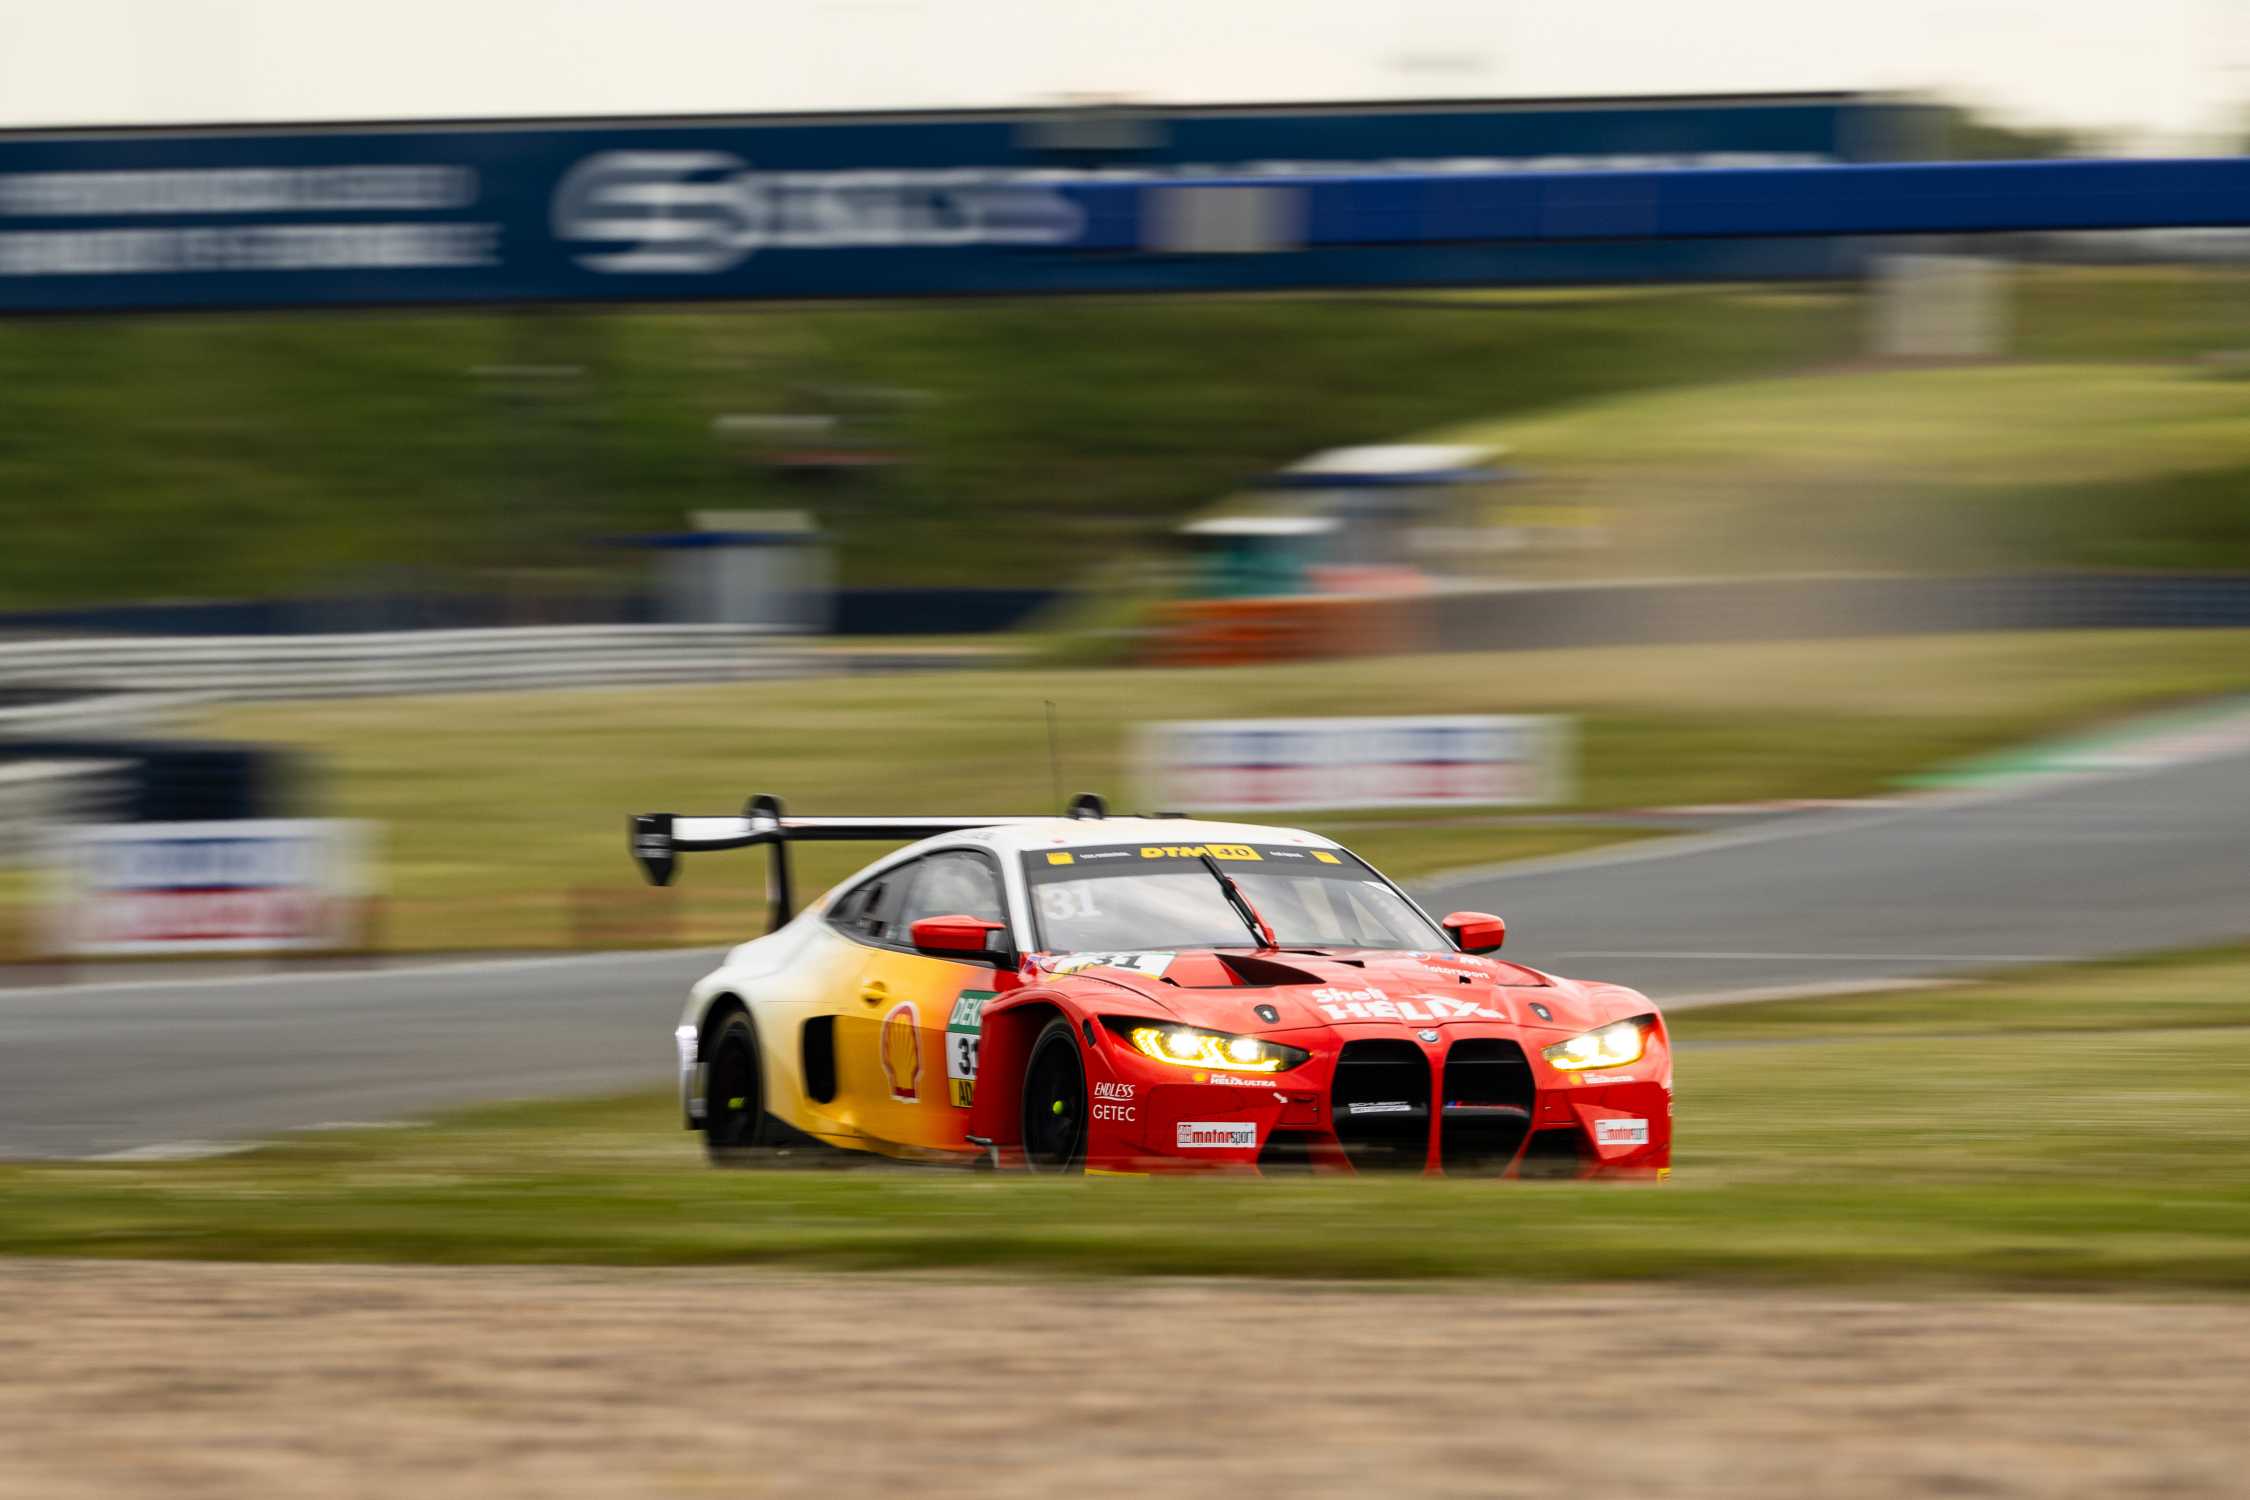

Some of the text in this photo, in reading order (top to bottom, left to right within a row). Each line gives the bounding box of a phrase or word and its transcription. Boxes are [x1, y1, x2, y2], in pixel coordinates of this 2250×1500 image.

[1140, 846, 1212, 859] DTM
[1047, 880, 1103, 920] 31
[1311, 986, 1389, 1002] Shell
[1319, 994, 1505, 1021] HELIX
[1094, 1081, 1136, 1098] ENDLESS
[1092, 1104, 1137, 1122] GETEC
